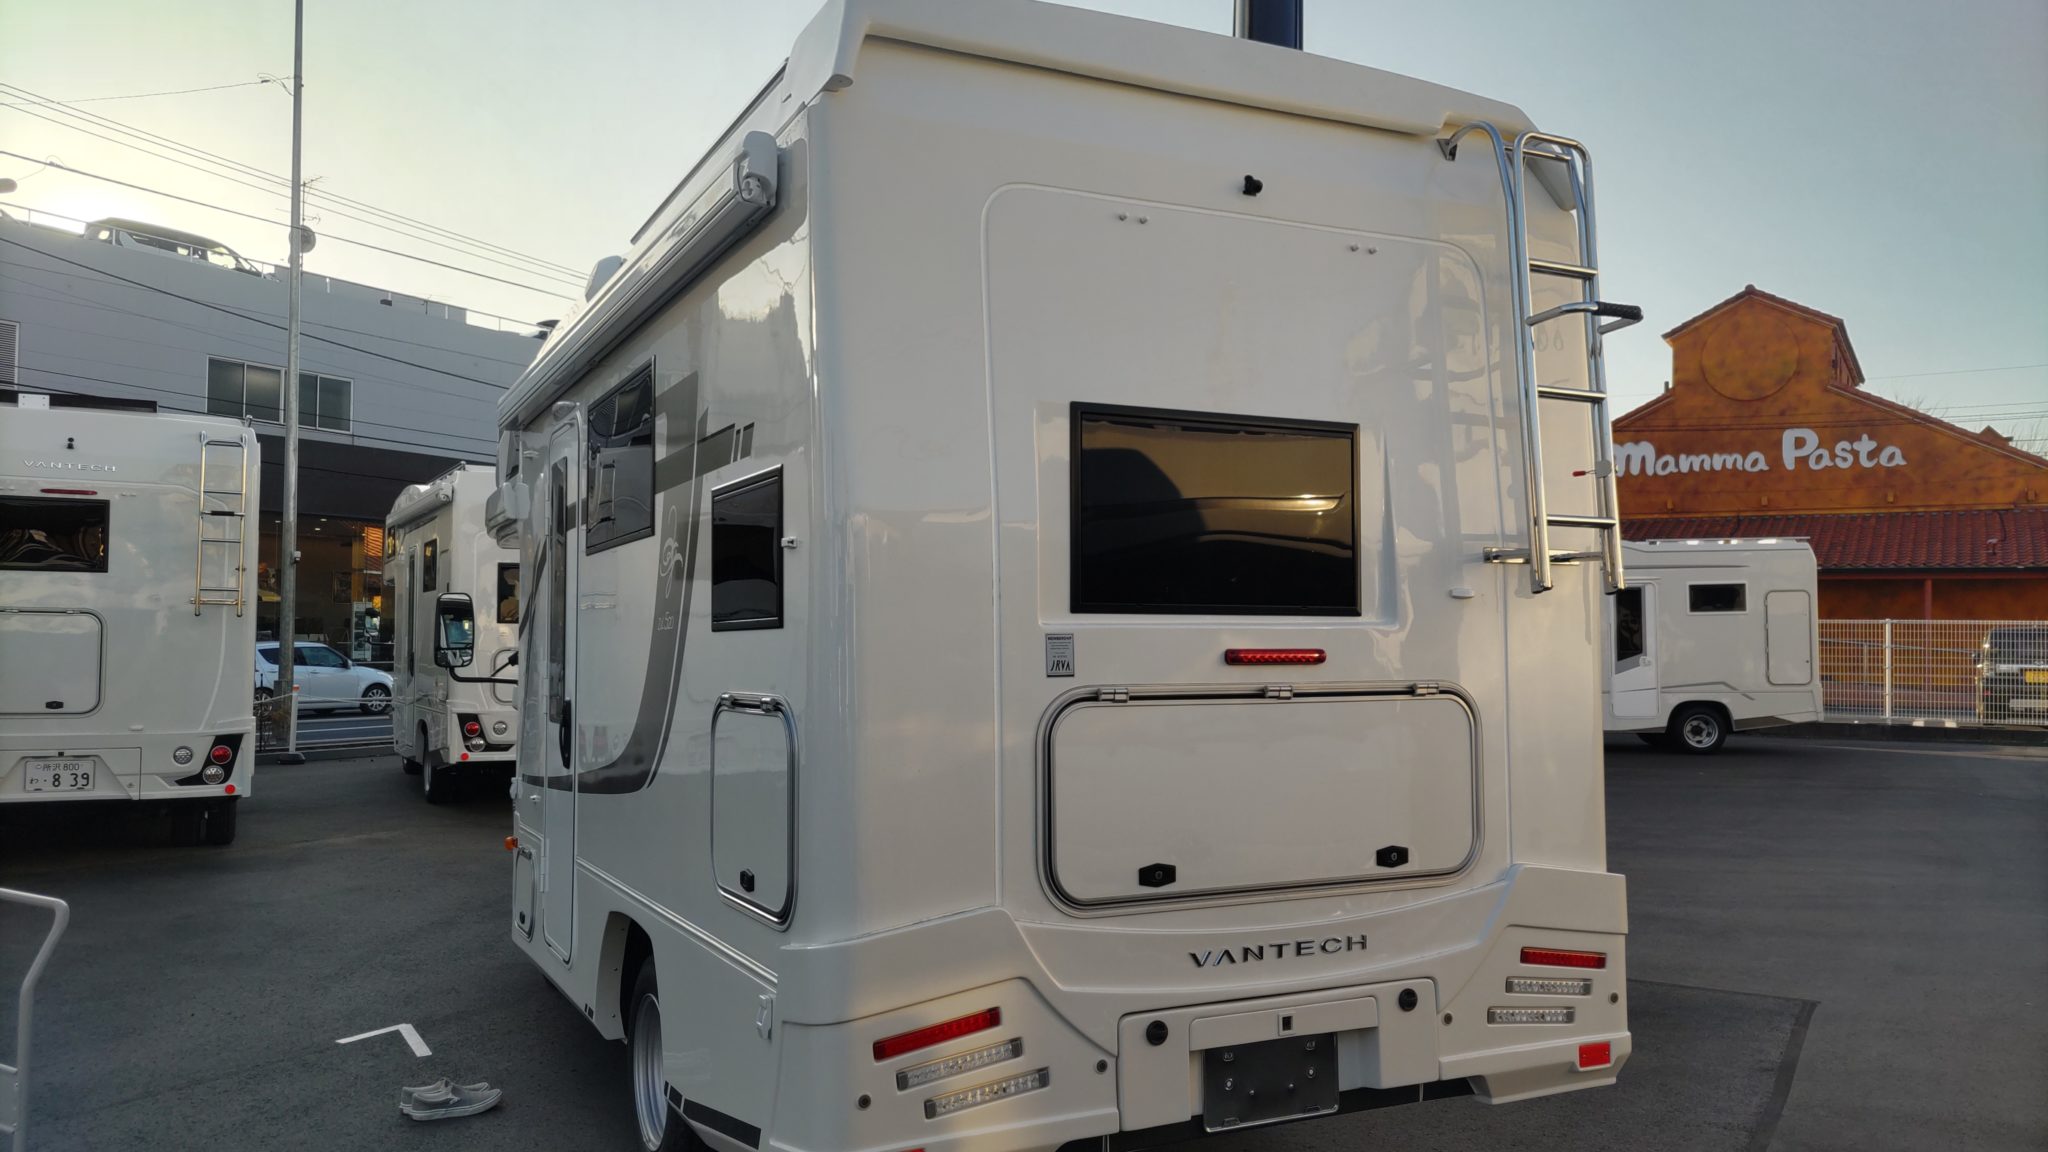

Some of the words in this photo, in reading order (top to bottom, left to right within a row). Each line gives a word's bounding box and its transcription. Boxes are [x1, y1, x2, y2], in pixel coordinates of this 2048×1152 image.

[1612, 440, 1769, 477] Mamma
[1782, 428, 1907, 471] Pasta
[24, 459, 117, 472] VANTECH
[62, 763, 80, 771] 800
[1189, 934, 1367, 968] VANTECH
